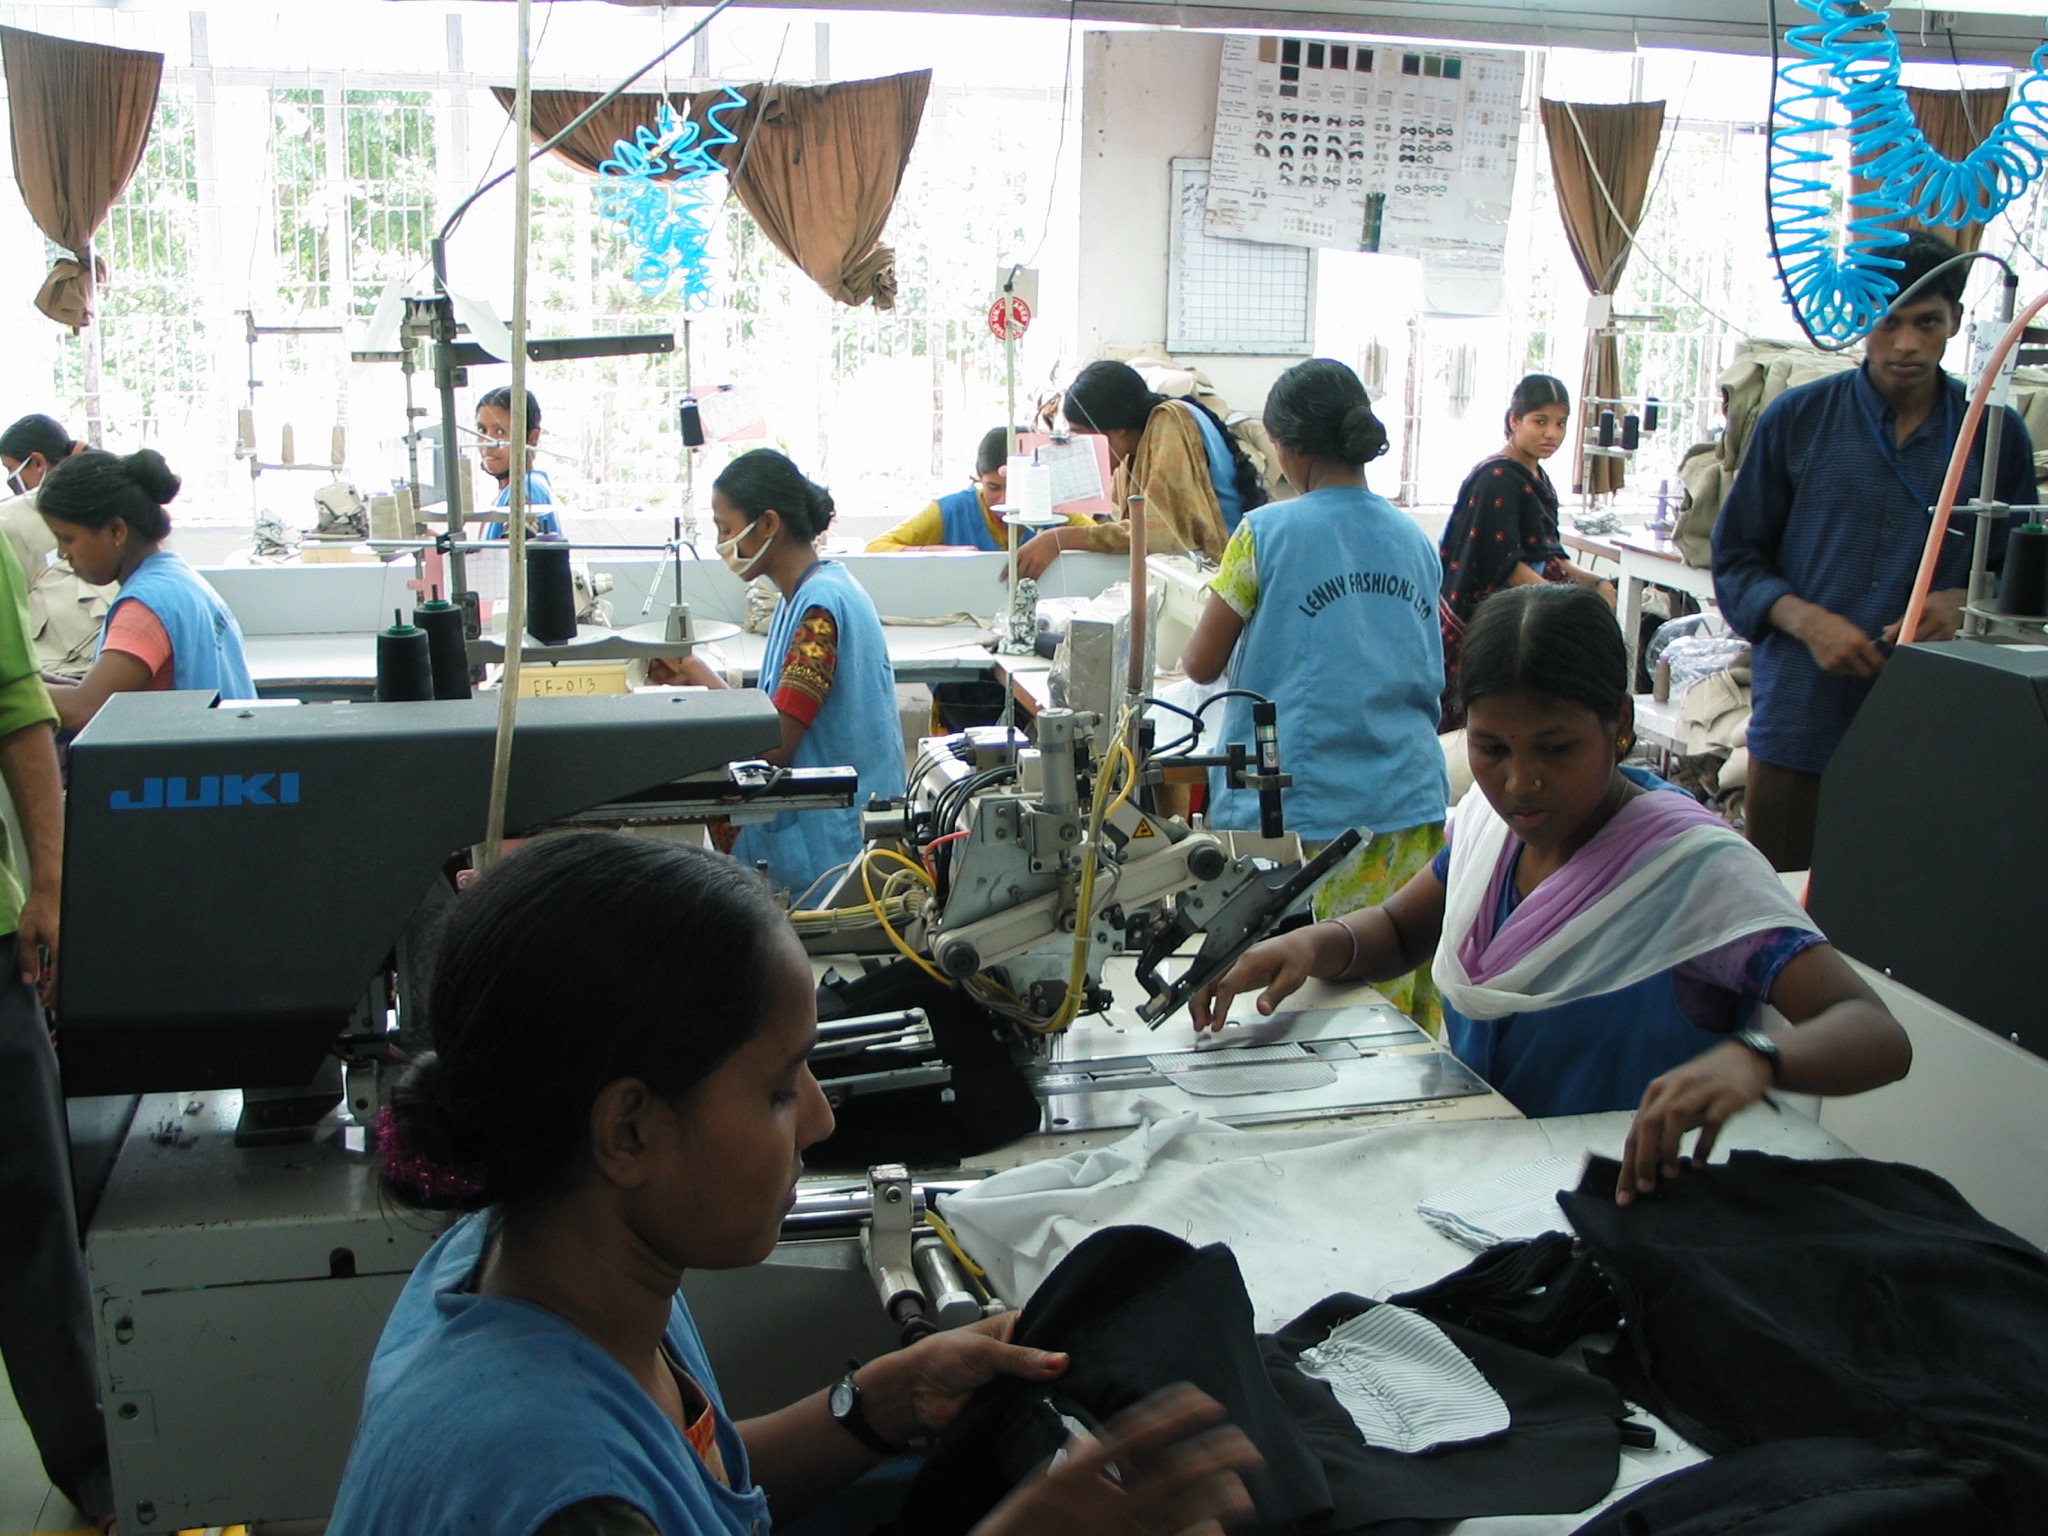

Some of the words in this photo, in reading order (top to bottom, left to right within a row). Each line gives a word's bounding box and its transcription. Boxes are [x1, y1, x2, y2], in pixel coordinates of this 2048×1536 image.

[1298, 575, 1345, 618] LENNY
[1349, 572, 1415, 603] FASHIONS
[533, 677, 596, 697] EF-013
[110, 772, 299, 810] JUKI
